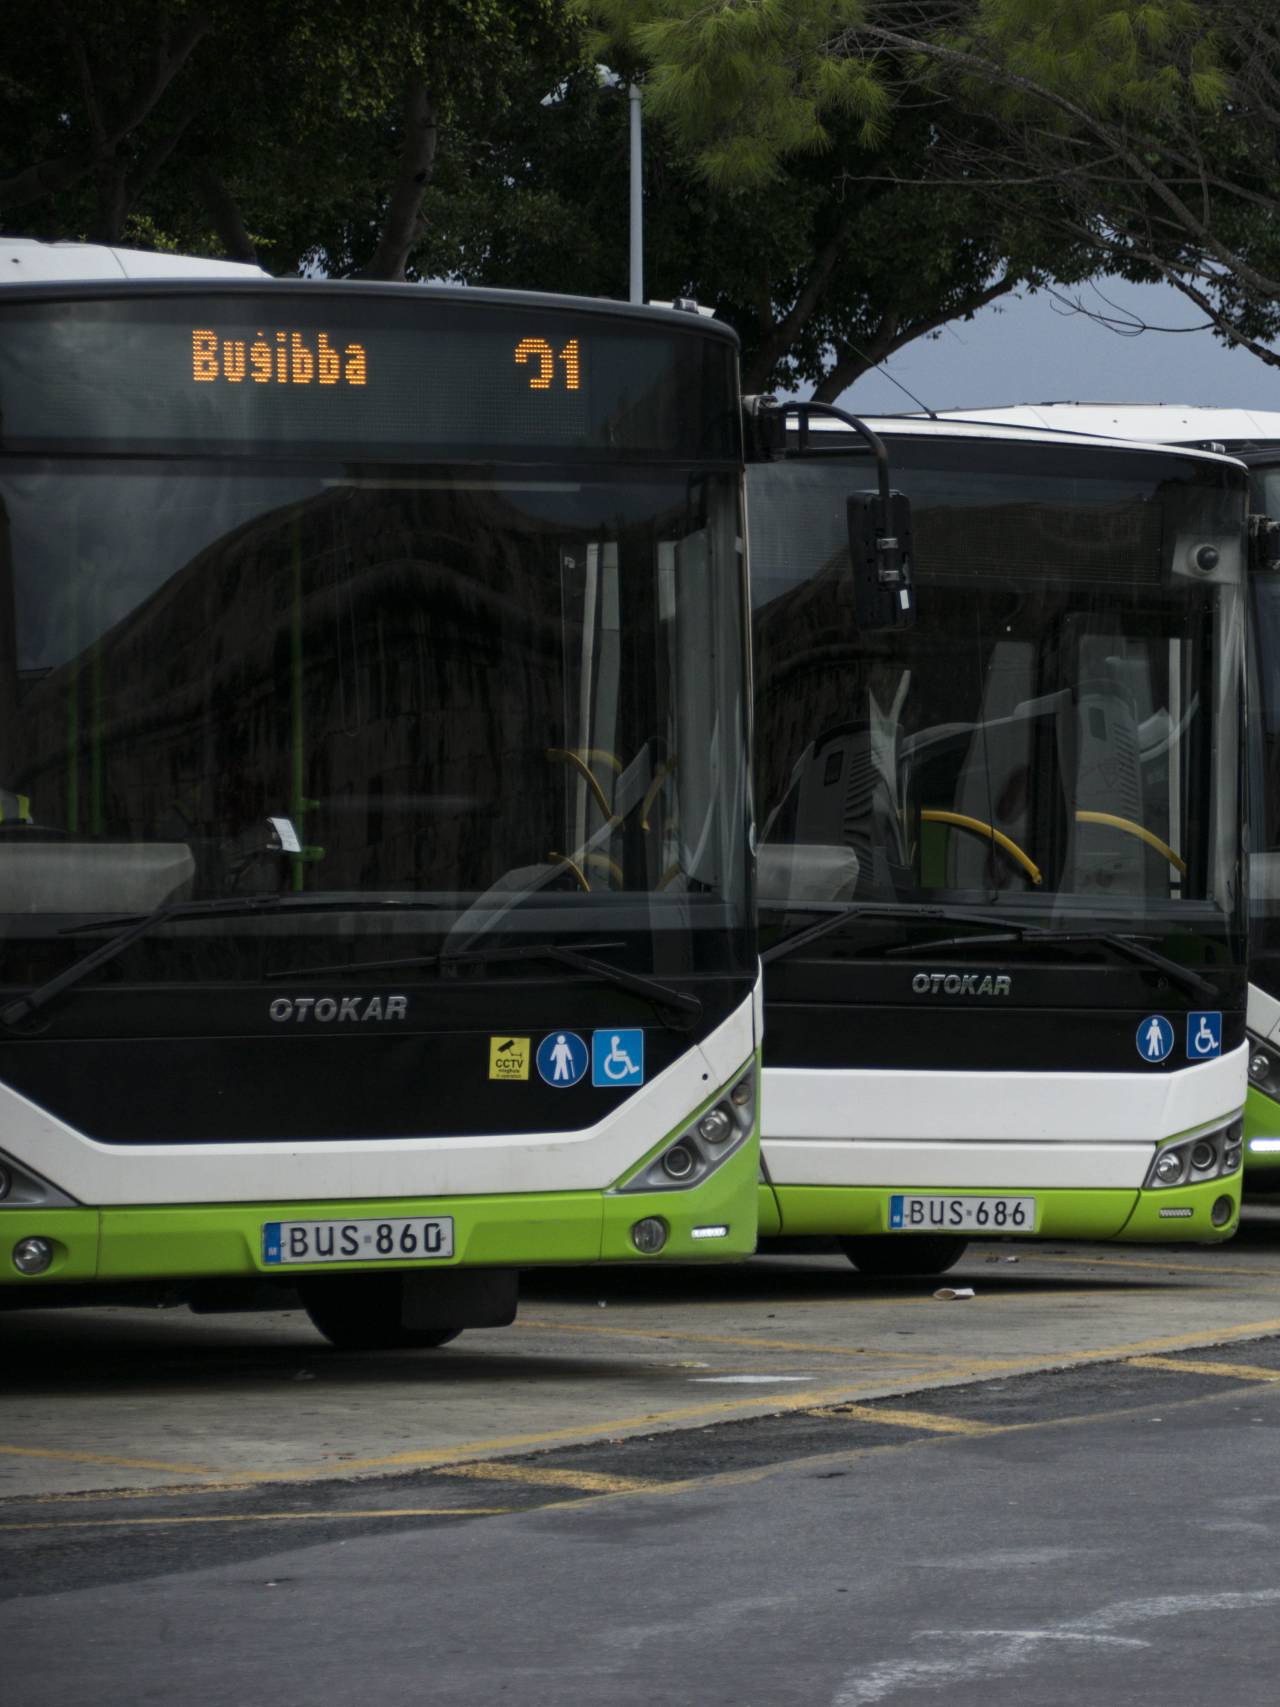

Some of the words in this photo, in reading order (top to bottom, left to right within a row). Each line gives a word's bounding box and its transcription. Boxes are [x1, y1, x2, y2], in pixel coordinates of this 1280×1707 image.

[911, 973, 1012, 996] OTOKAR
[269, 996, 408, 1022] OTOKAR
[495, 1059, 523, 1069] CCTV
